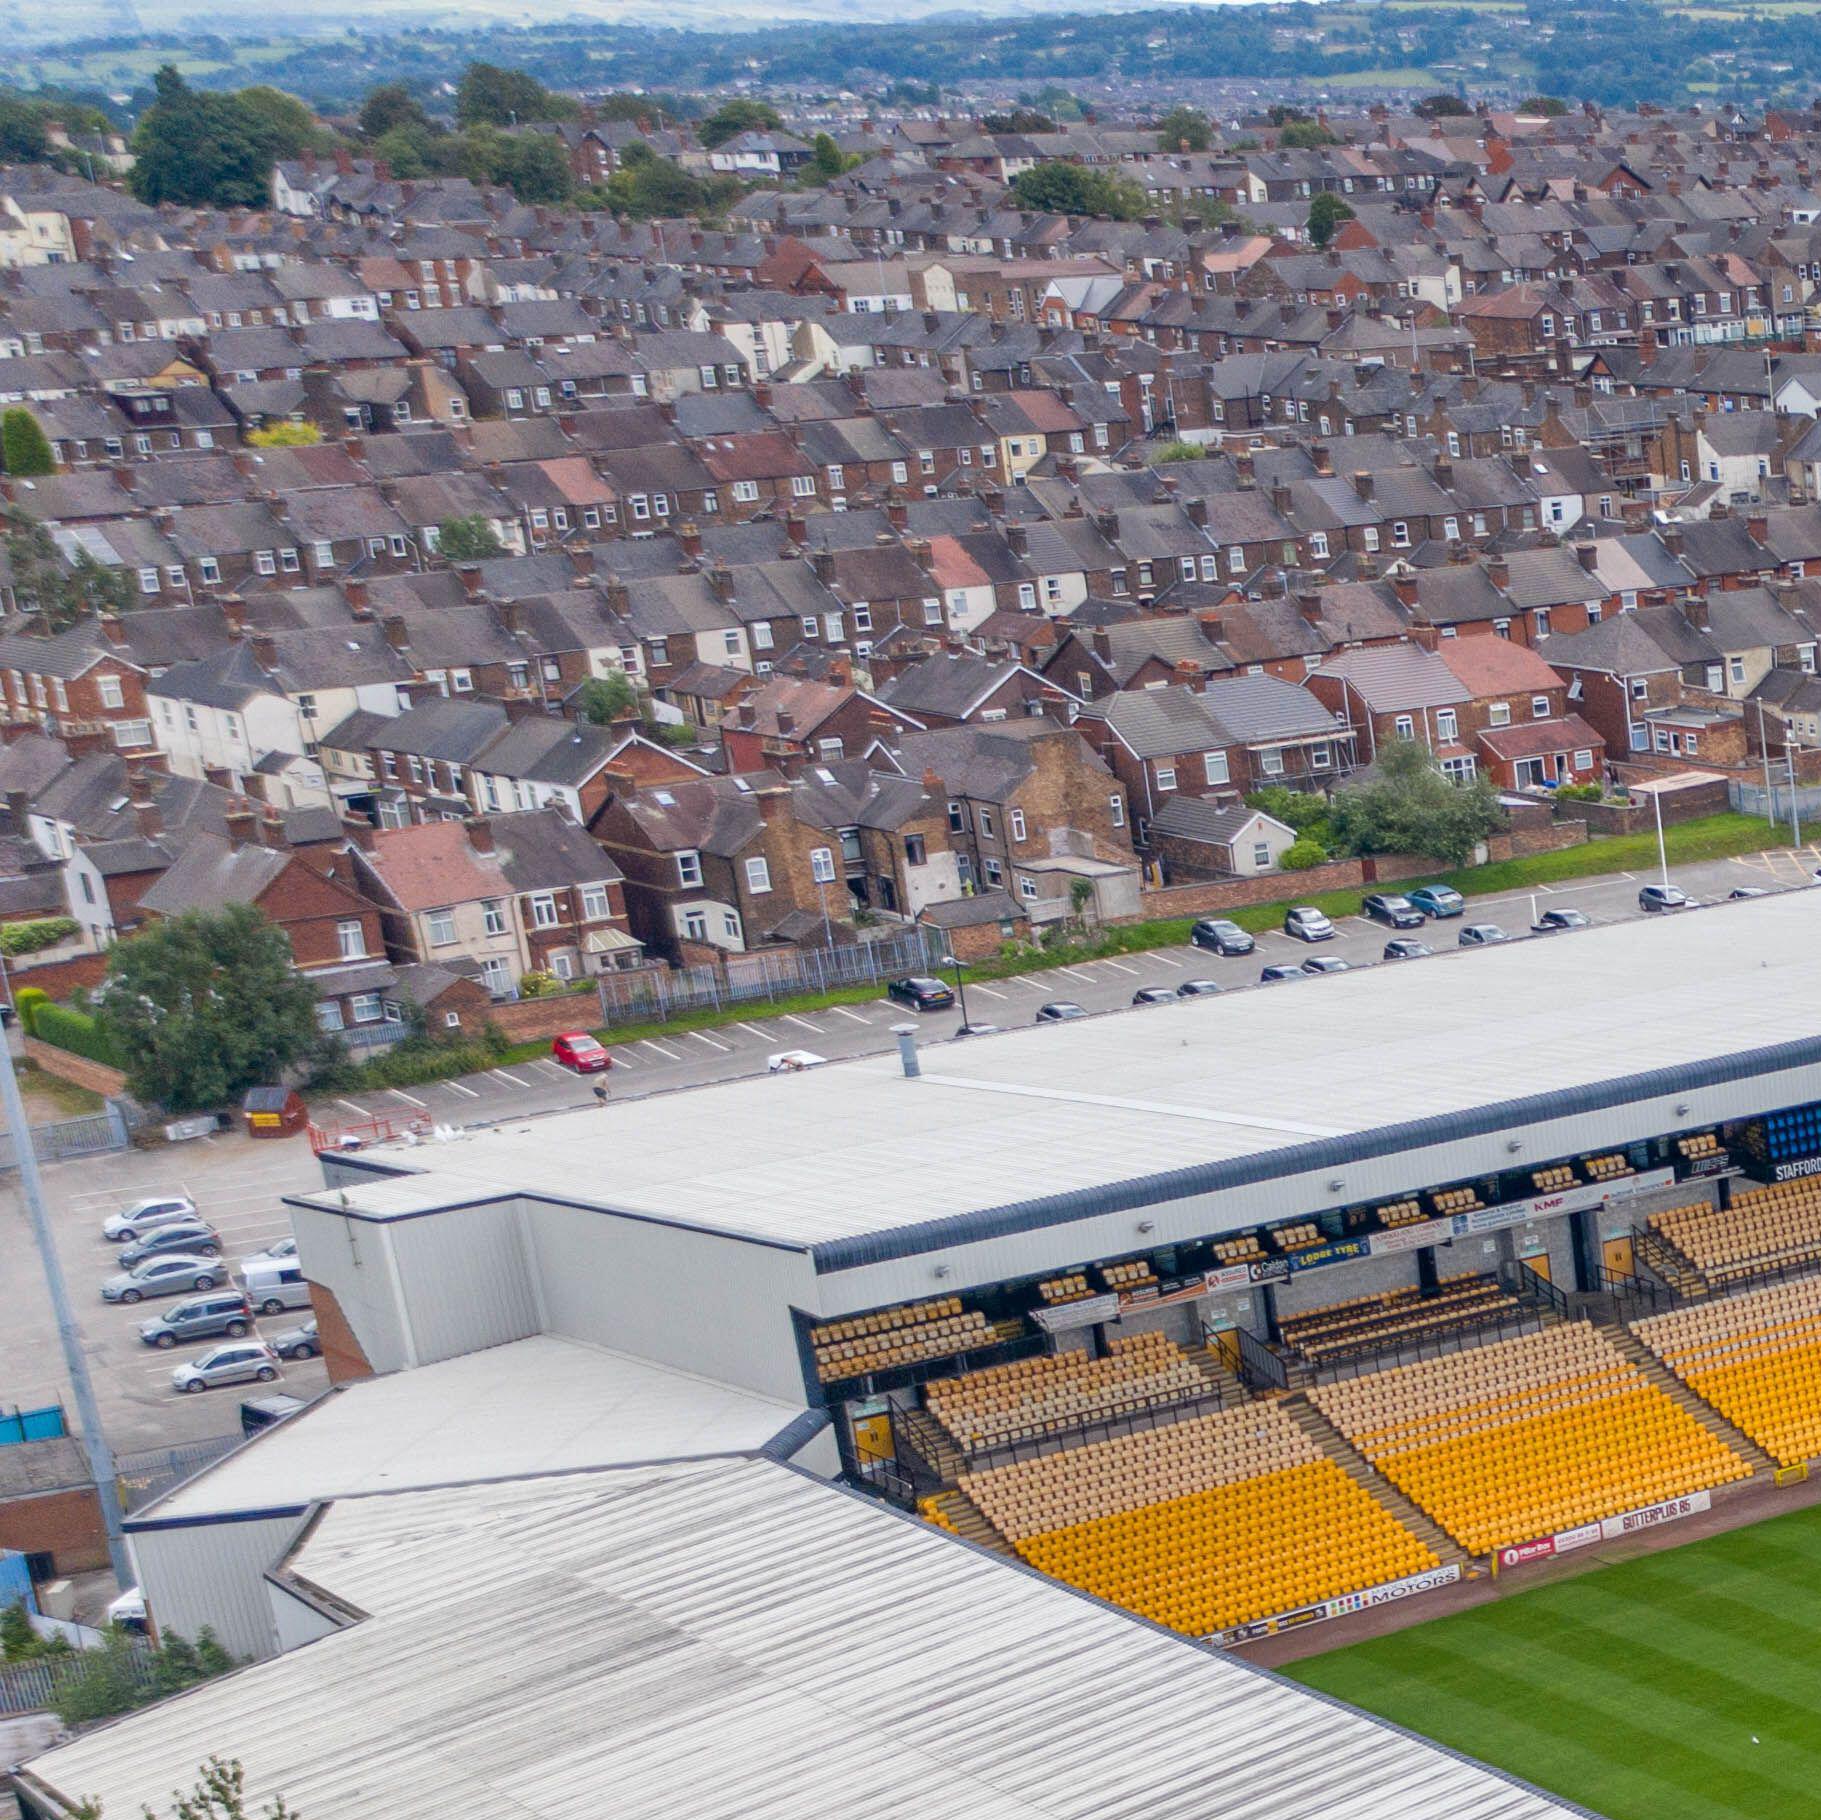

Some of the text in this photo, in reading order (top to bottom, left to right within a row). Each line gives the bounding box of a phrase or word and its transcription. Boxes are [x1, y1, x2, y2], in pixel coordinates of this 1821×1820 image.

[1534, 1197, 1564, 1213] KMF
[1300, 1249, 1332, 1266] LODGE
[1622, 1502, 1678, 1530] GUTTERPLUS
[1372, 1572, 1457, 1603] MOTORS
